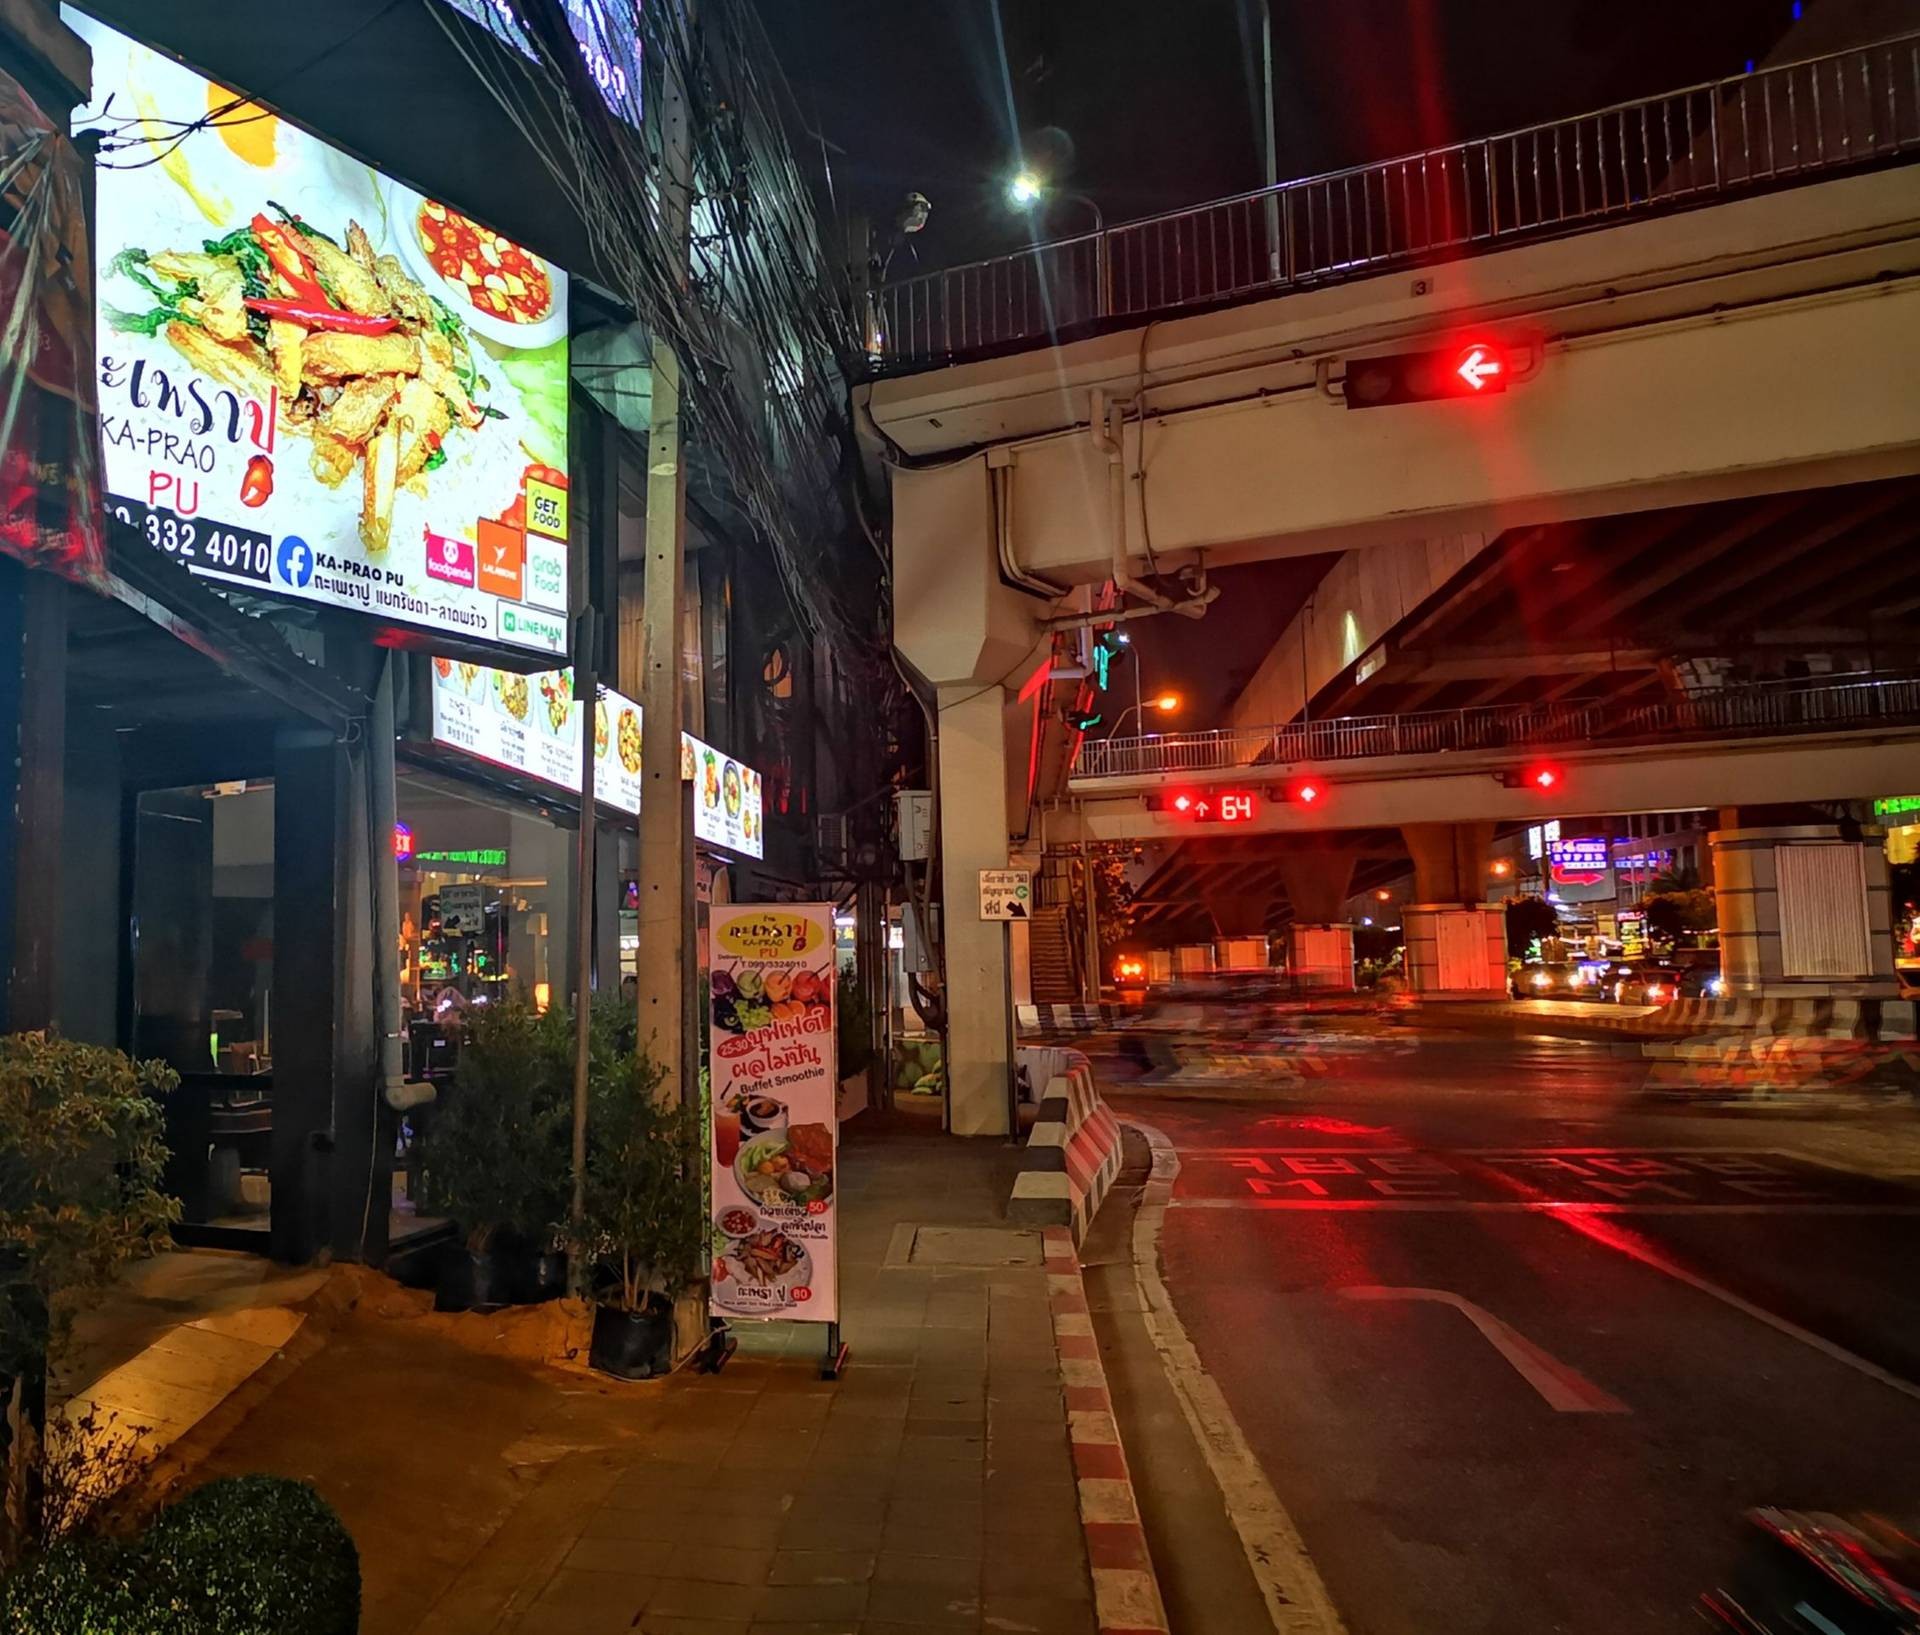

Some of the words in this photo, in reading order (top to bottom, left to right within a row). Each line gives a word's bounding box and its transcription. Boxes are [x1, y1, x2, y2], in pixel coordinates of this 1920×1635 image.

[100, 413, 215, 473] KA-PRAO
[149, 470, 198, 515] PU
[534, 496, 559, 514] GET
[533, 511, 561, 529] FOOD
[146, 514, 196, 557] 332
[205, 531, 270, 574] 4010
[316, 552, 382, 581] KA-PRAO
[386, 570, 404, 587] PU
[532, 554, 562, 577] Grab
[534, 574, 560, 594] Food
[1221, 795, 1252, 820] 64
[759, 948, 778, 958] PU
[732, 1040, 822, 1078] ผลไม้ปั่น
[740, 1078, 774, 1094] Buffet
[775, 1067, 825, 1087] Smoothie
